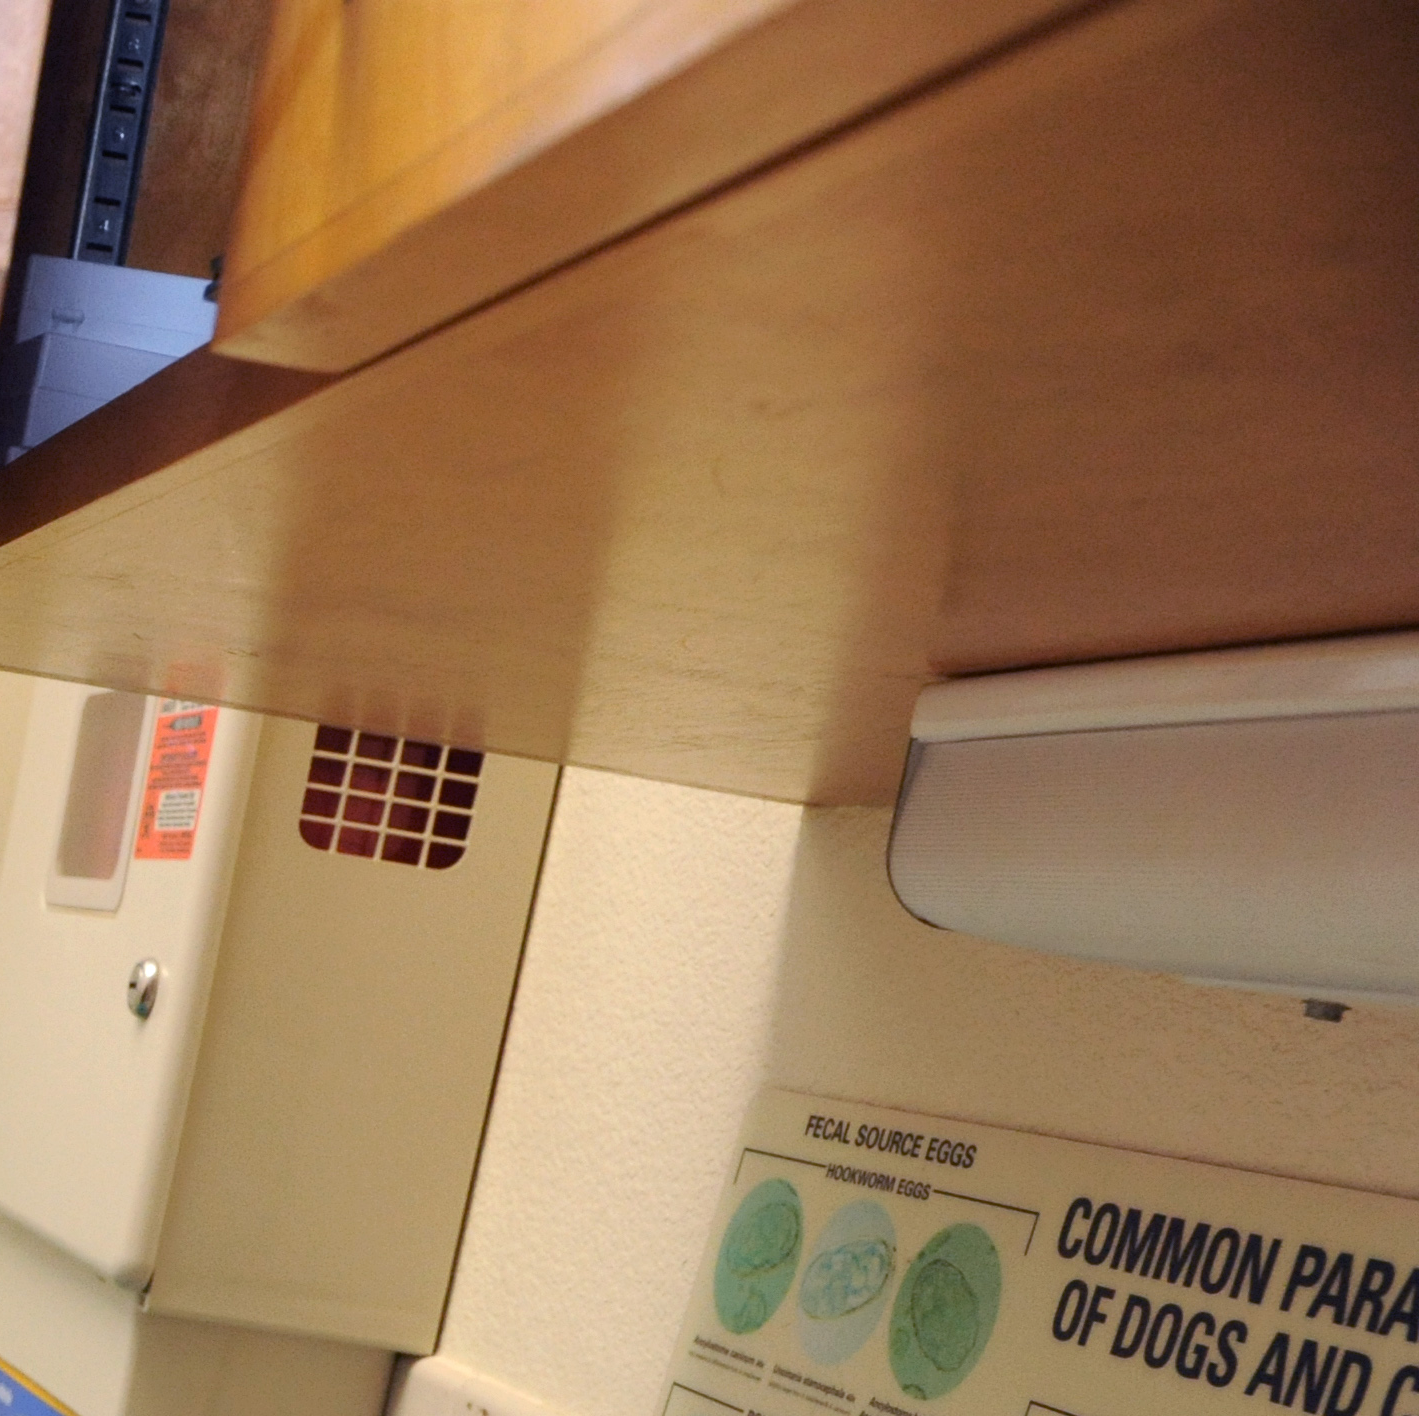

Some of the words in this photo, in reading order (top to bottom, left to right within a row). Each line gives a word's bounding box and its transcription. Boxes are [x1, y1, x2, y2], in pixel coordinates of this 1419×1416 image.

[804, 1114, 851, 1145] FECAL
[855, 1124, 924, 1158] SOURCE
[925, 1137, 978, 1168] EGGS
[825, 1163, 896, 1192] HOOKWORM
[896, 1178, 932, 1201] EGGS
[1057, 1197, 1282, 1305] COMMON
[1279, 1244, 1419, 1343] PARA
[1052, 1279, 1116, 1347] OF
[1109, 1294, 1248, 1388] DOGS
